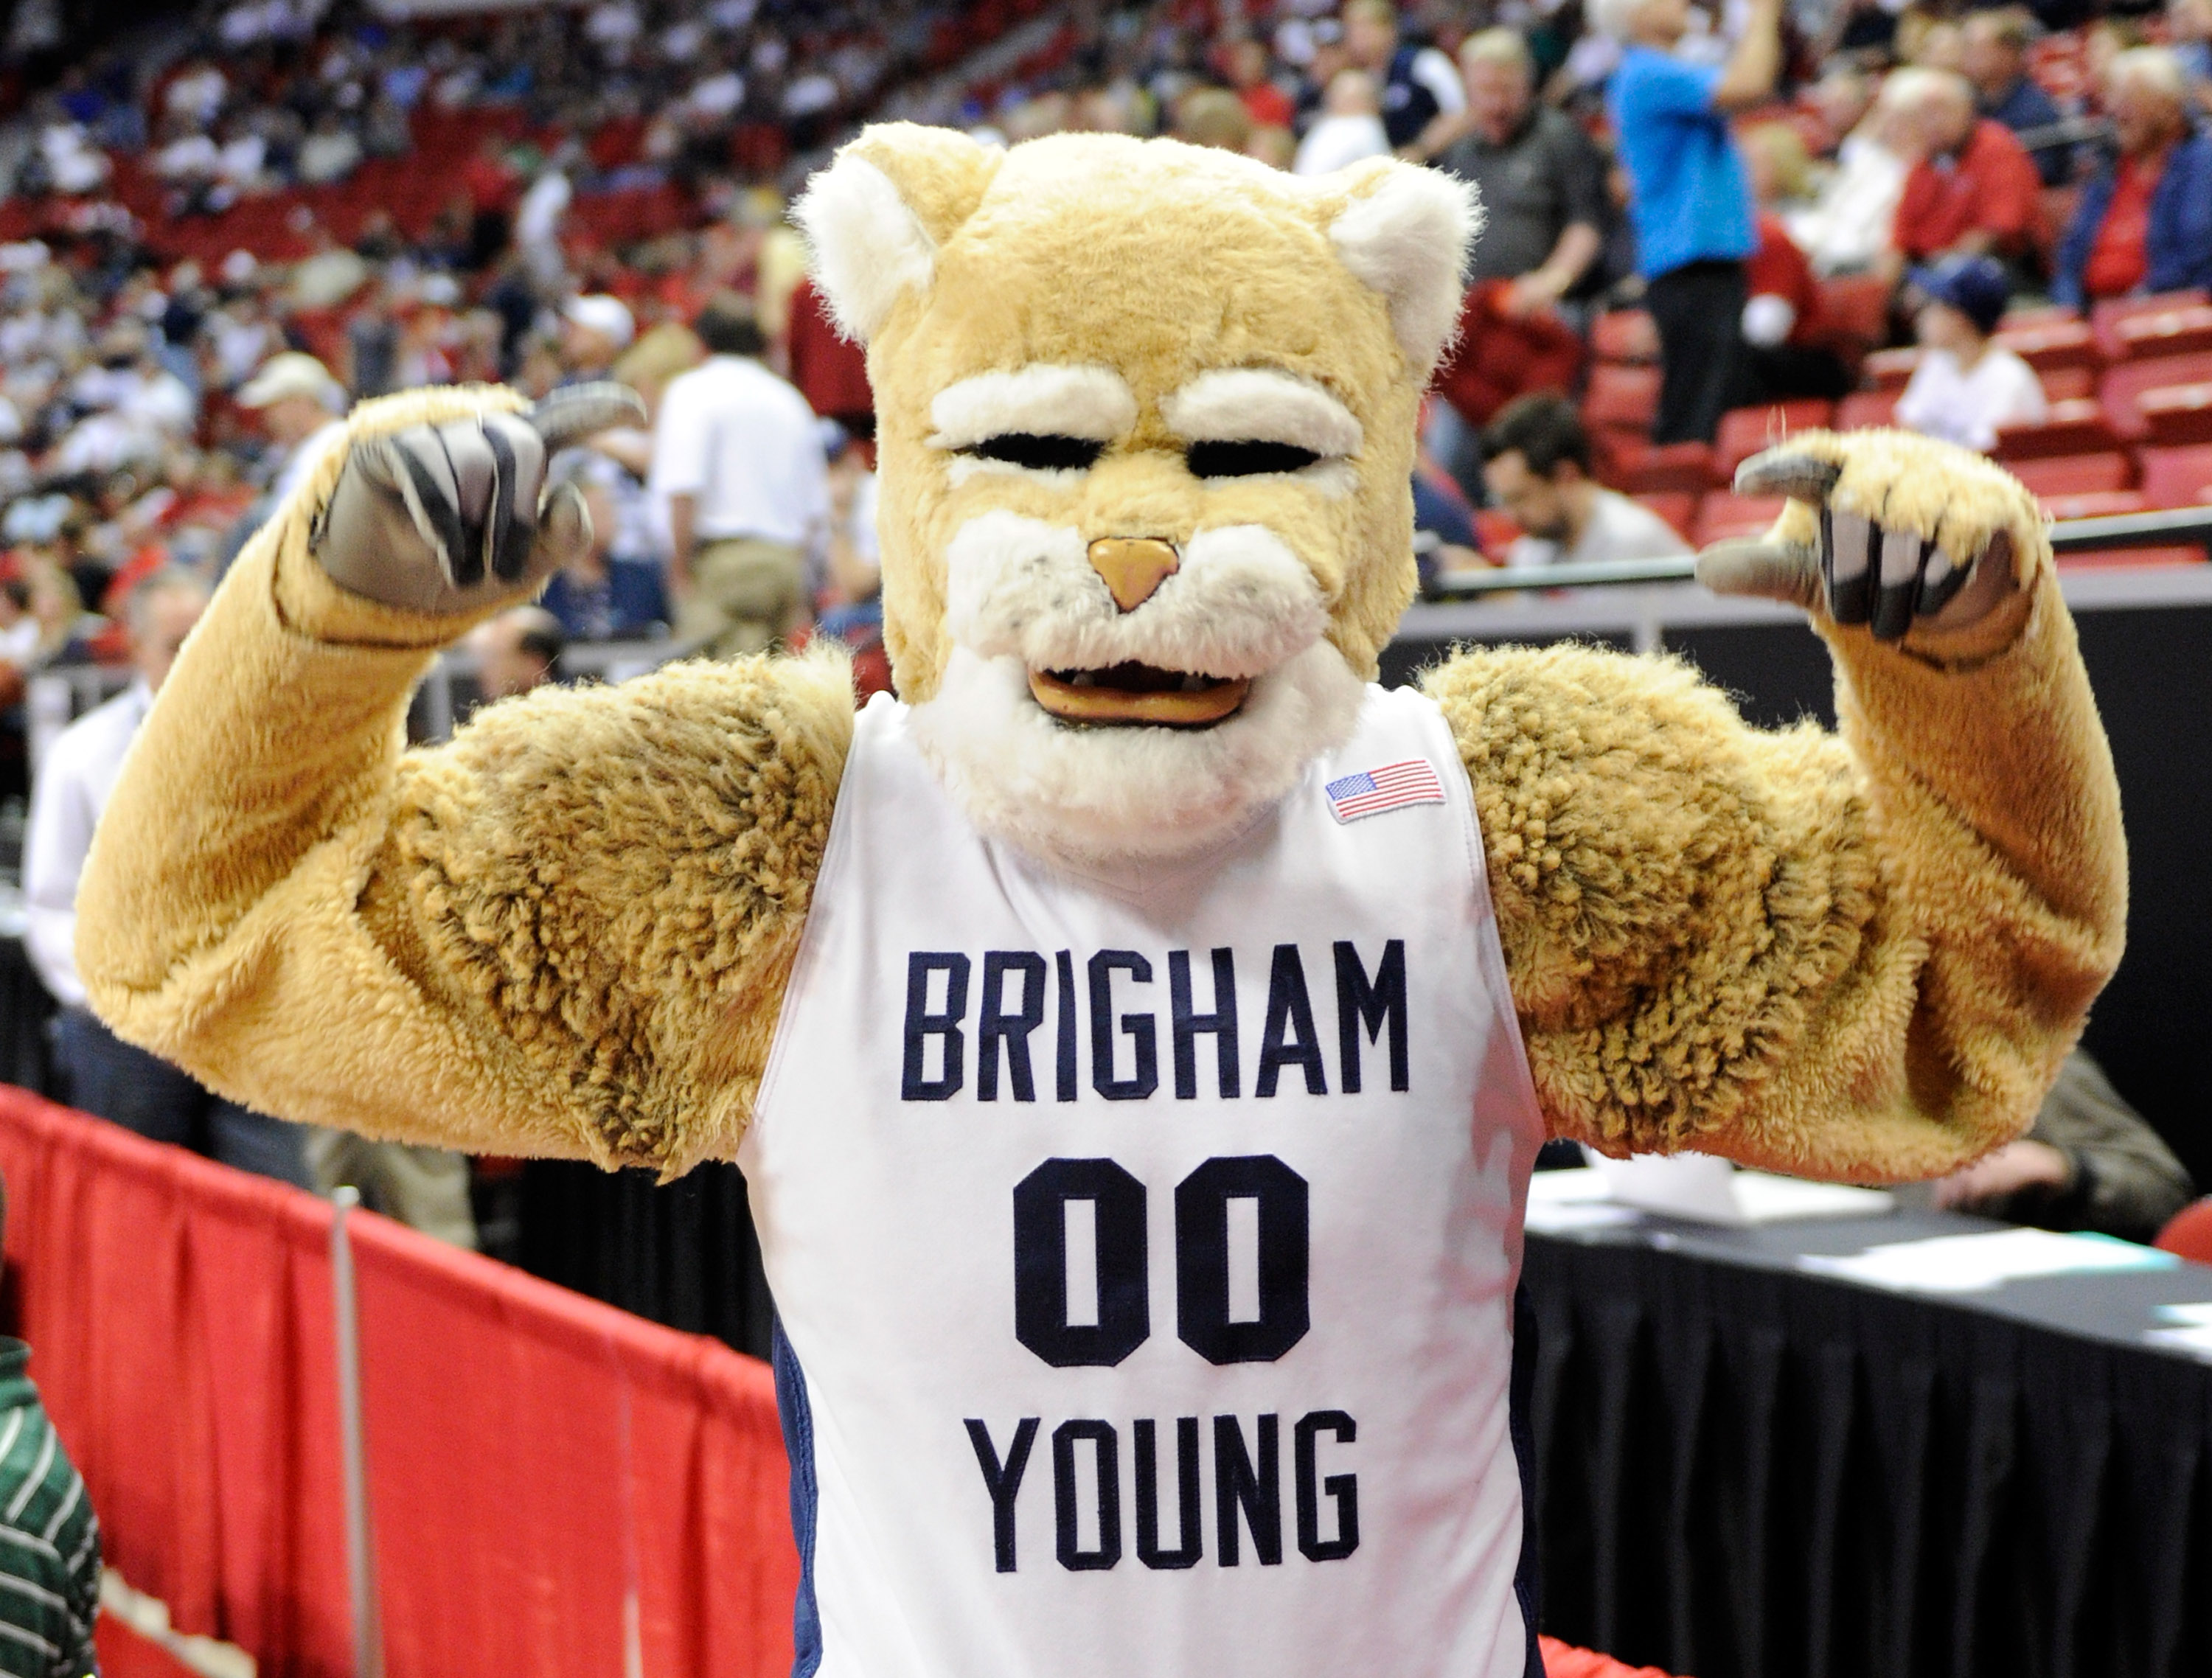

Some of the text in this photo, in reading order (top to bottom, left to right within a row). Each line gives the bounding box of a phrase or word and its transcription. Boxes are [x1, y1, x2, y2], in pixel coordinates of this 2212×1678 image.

[901, 939, 1409, 1101] BRIGHAM
[1013, 1155, 1310, 1368] 00
[964, 1410, 1360, 1573] YOUNG
